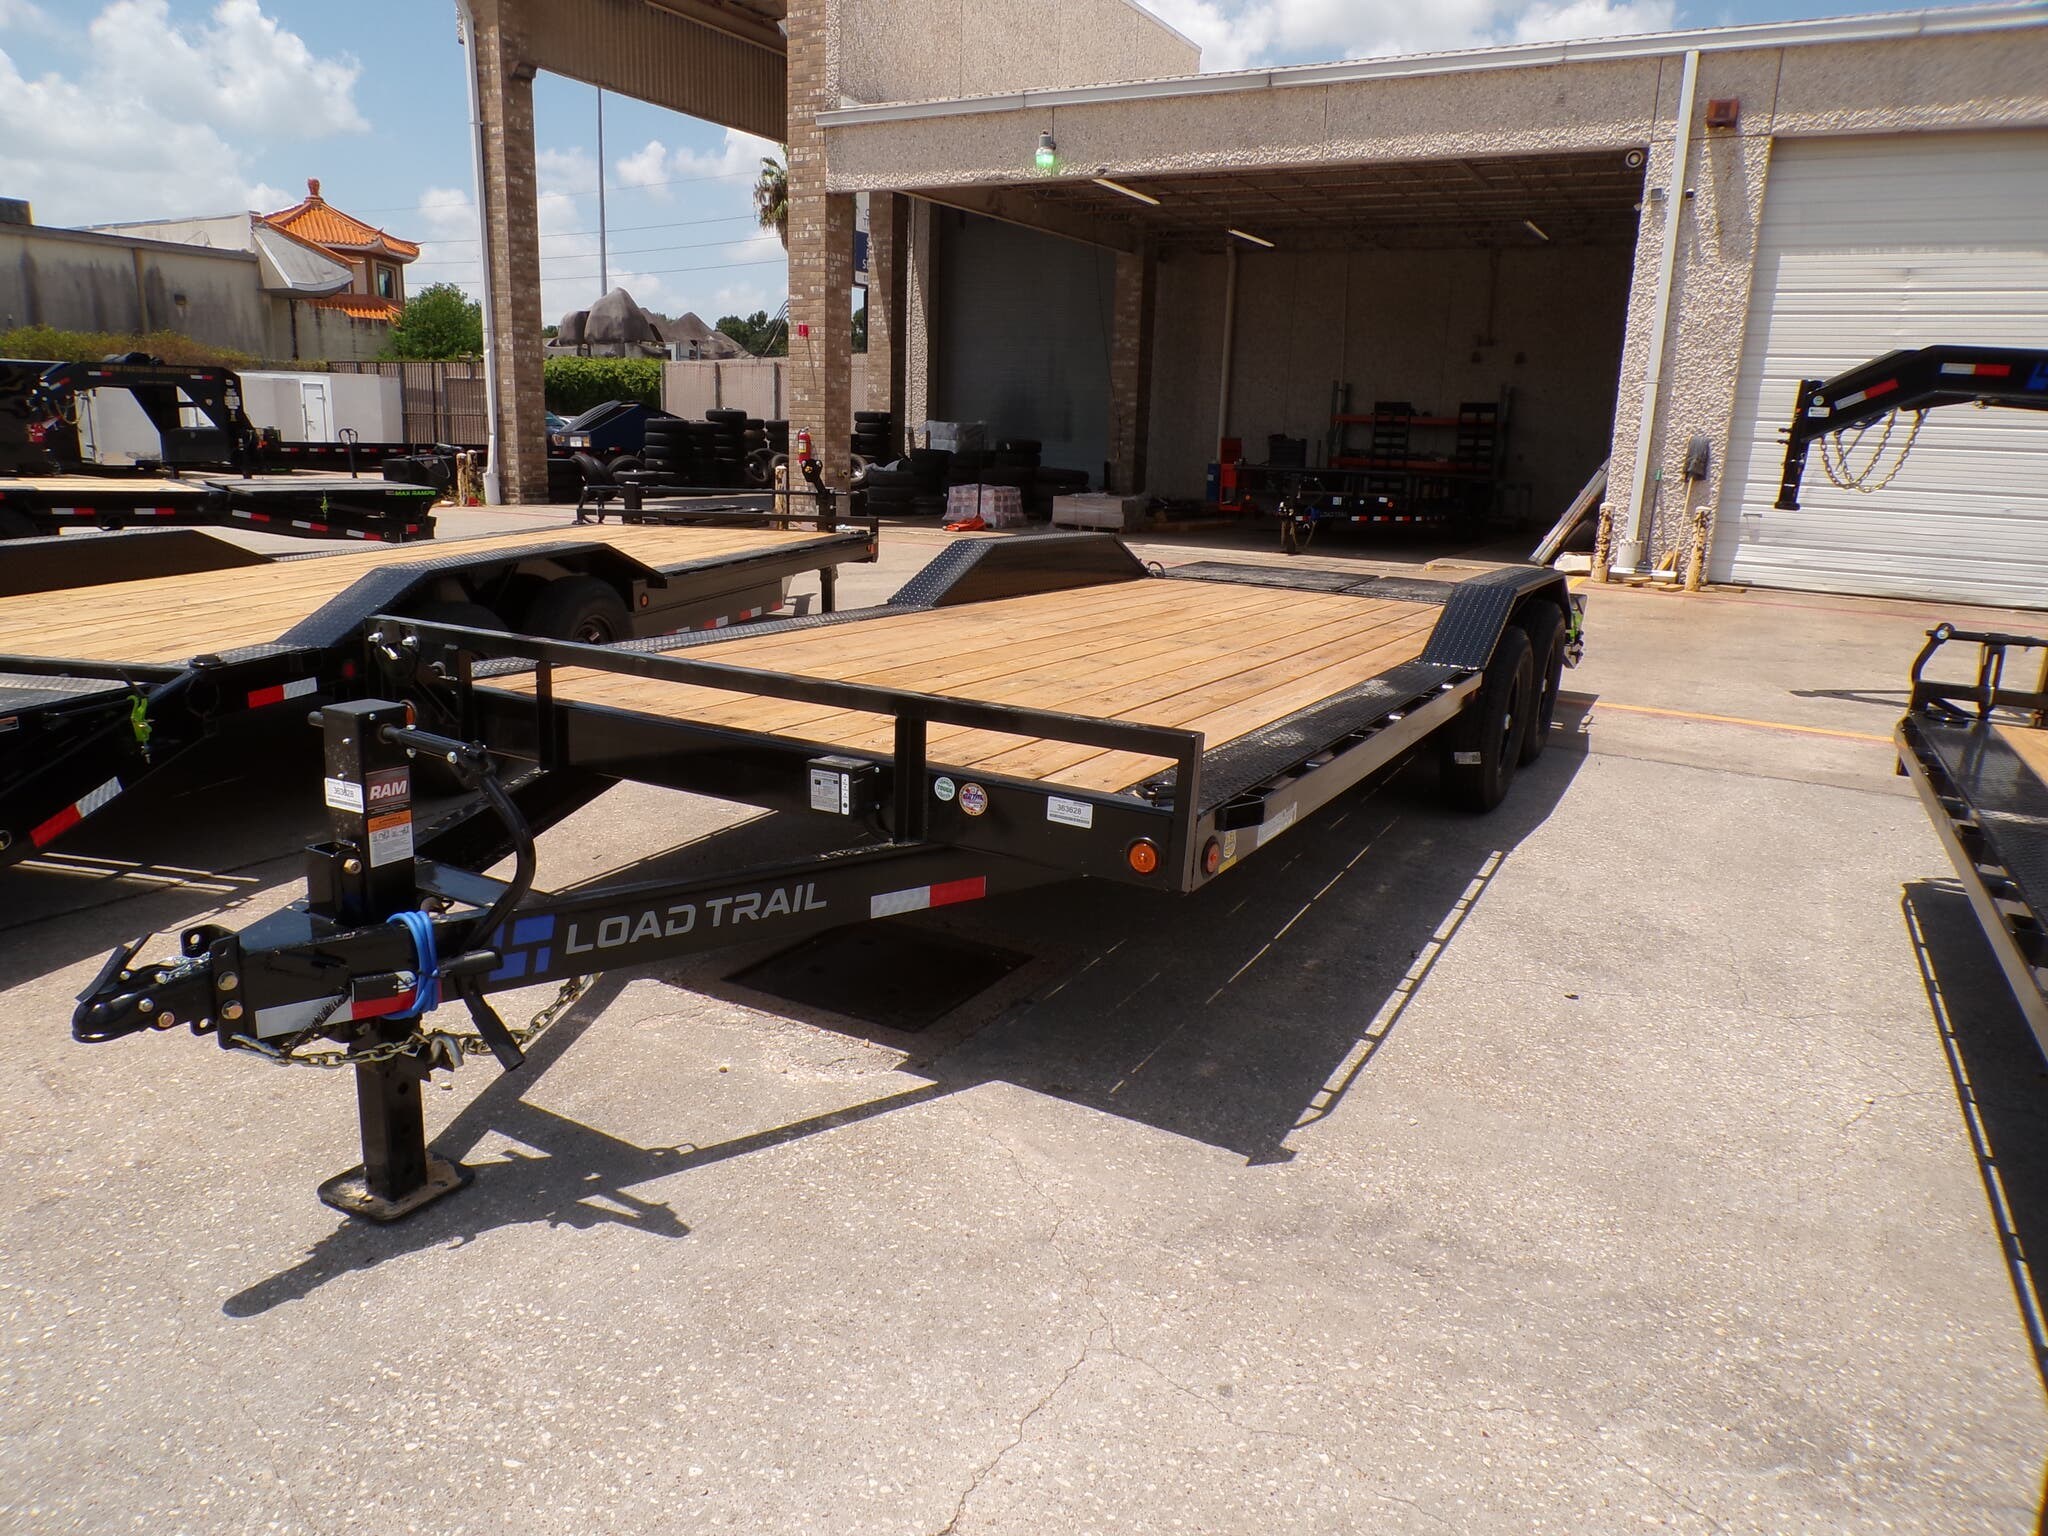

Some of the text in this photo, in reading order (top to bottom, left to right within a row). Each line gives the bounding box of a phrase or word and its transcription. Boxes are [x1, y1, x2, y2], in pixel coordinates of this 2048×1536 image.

[369, 780, 408, 801] RAM
[565, 882, 828, 955] LOAD TRAIL
